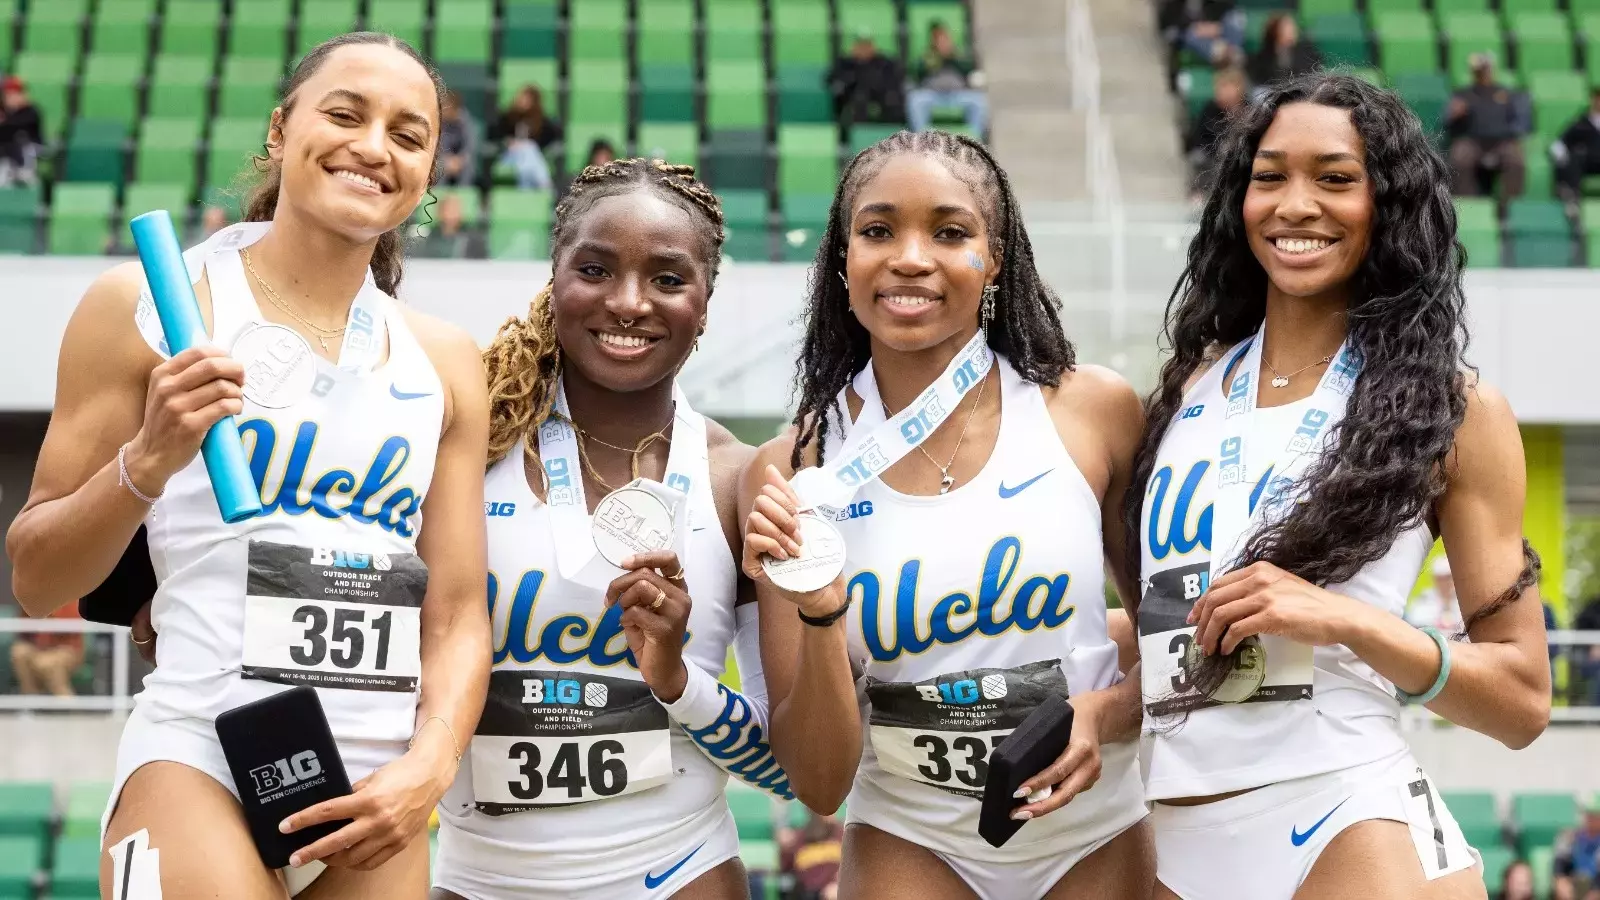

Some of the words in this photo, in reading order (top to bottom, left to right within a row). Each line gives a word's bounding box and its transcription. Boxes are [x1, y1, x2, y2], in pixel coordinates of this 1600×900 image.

[323, 570, 357, 580] OUTDOOR
[359, 573, 382, 582] TRACK
[334, 580, 350, 588] AND
[351, 581, 371, 589] FIELD
[324, 587, 379, 598] CHAMPIONSHIPS
[848, 534, 1075, 662] Ucla
[289, 605, 392, 670] 351
[532, 707, 568, 715] OUTDOOR
[570, 708, 594, 717] TRACK
[972, 703, 998, 712] TRACK
[534, 722, 593, 730] CHAMPIONSHIPS
[940, 718, 997, 726] CHAMPIONSHIPS
[508, 739, 628, 800] 346
[260, 796, 272, 805] BIG
[271, 791, 285, 801] TEN
[284, 776, 327, 796] CONFERENCE
